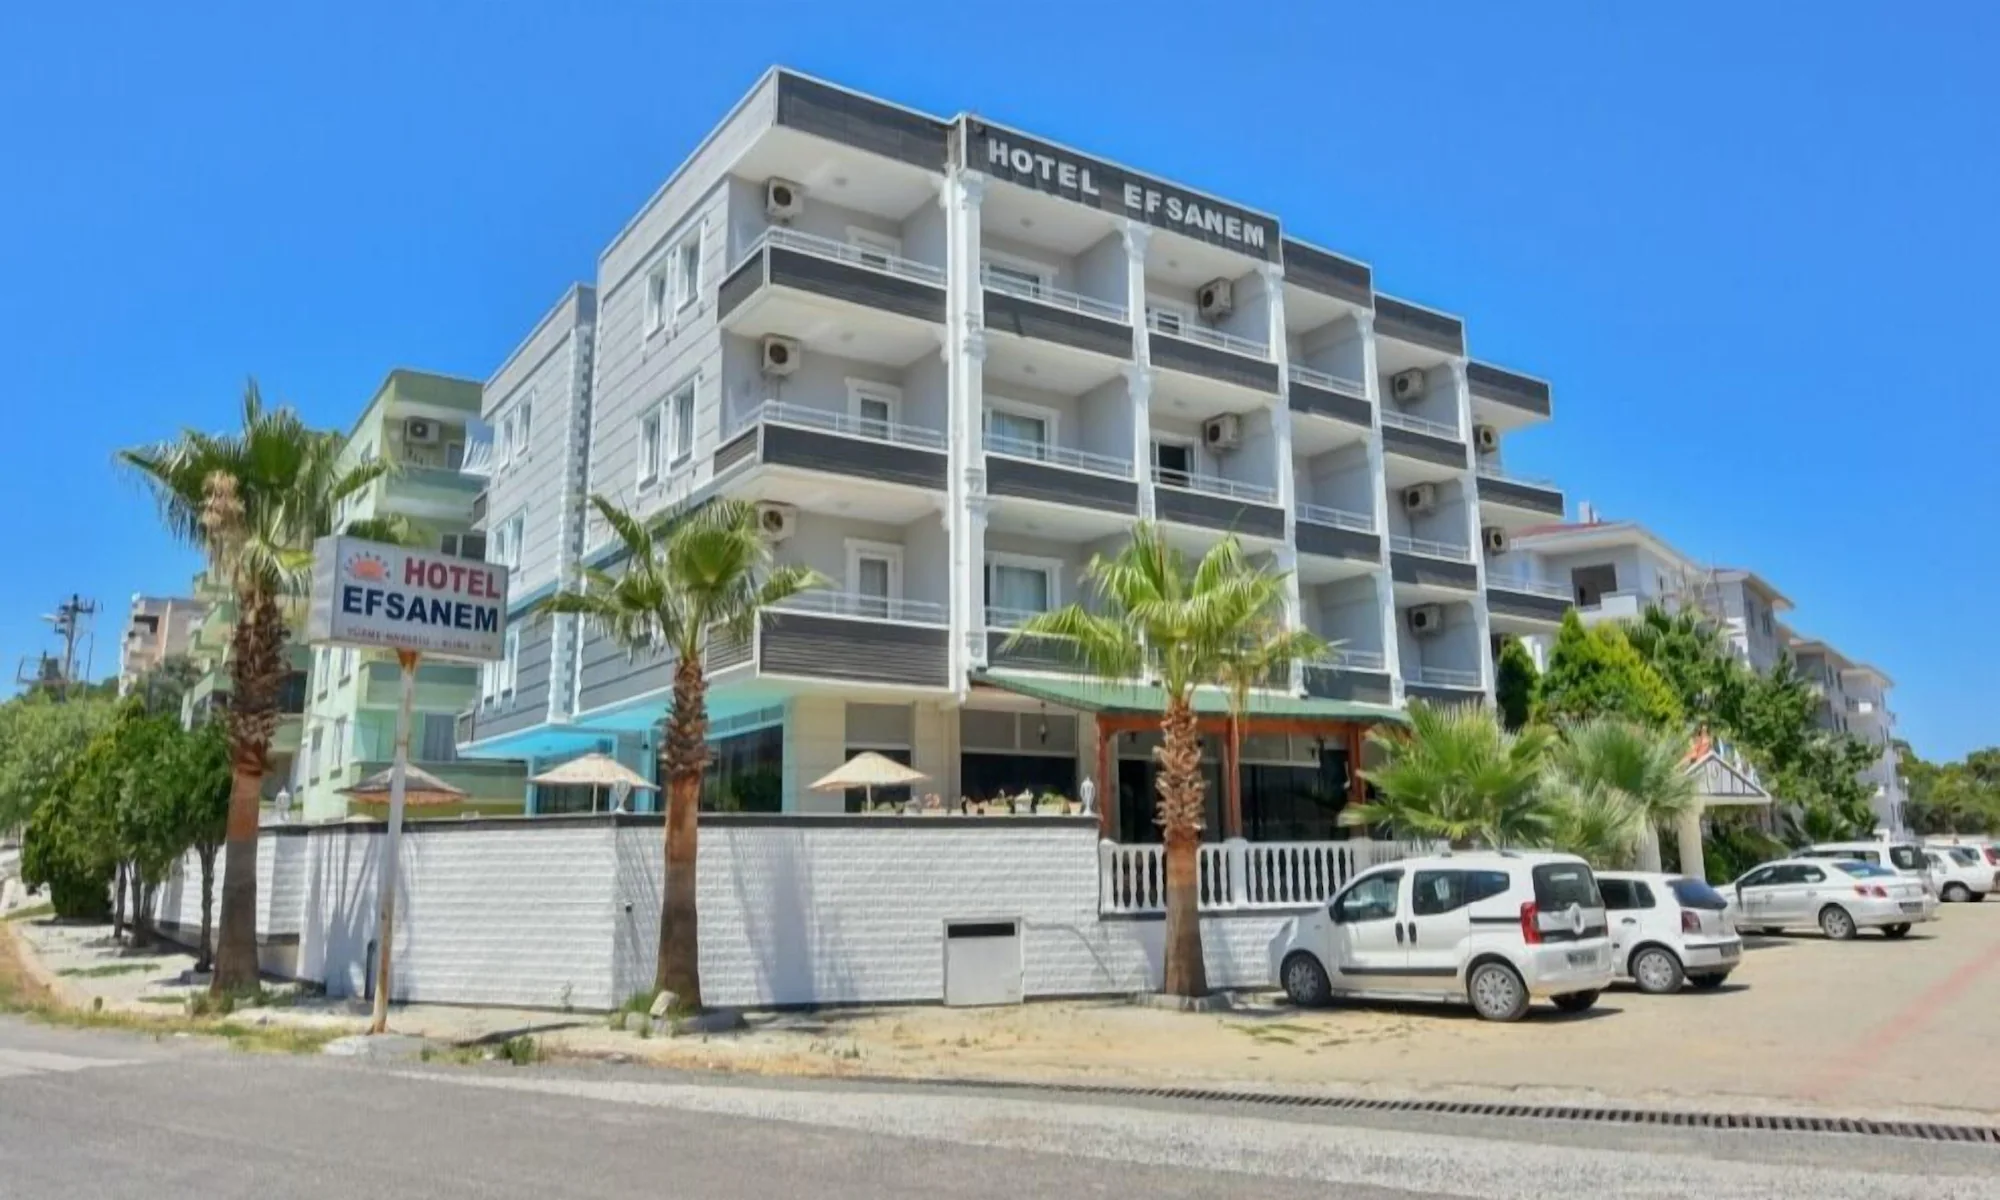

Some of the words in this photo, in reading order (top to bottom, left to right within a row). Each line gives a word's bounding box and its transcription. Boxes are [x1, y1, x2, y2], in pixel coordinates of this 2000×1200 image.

[988, 138, 1100, 197] HOTEL
[1123, 182, 1265, 249] EFSANEM
[404, 557, 501, 599] HOTEL
[342, 584, 499, 633] EFSANEM
